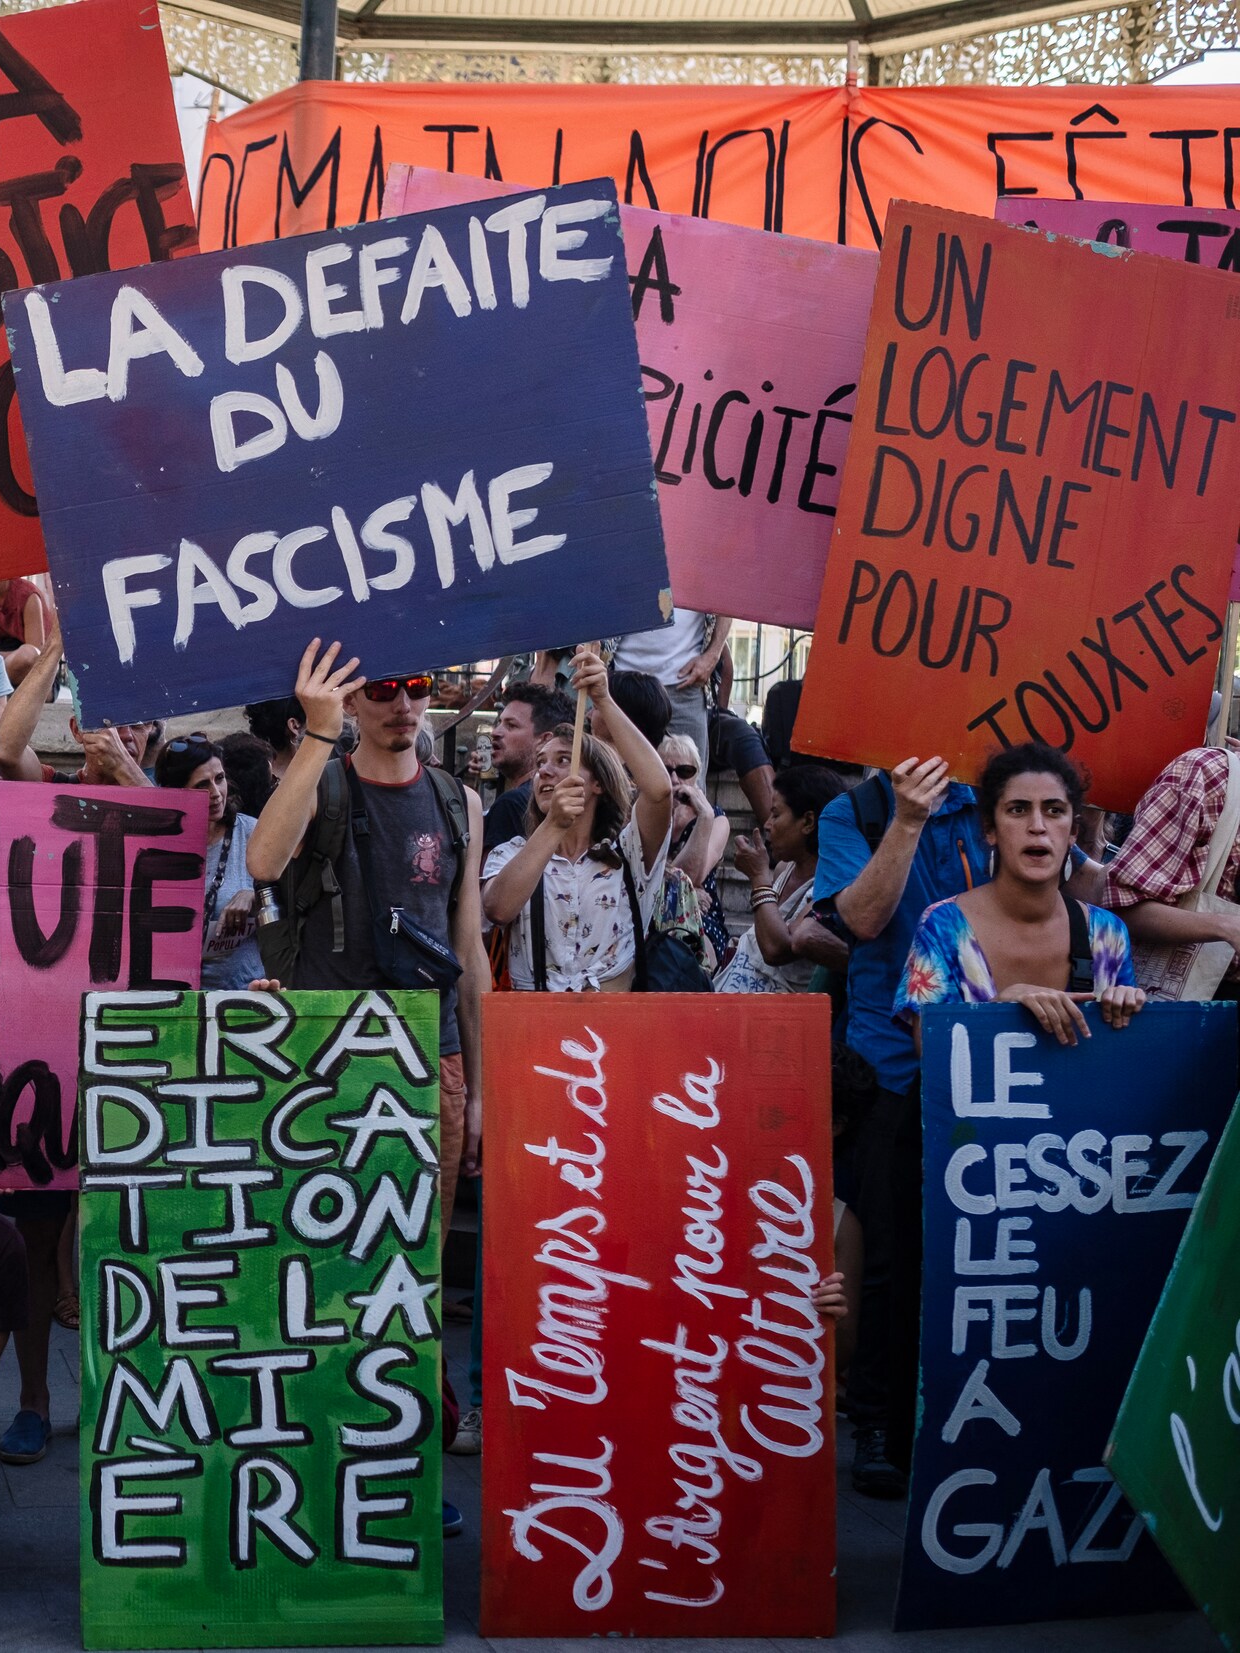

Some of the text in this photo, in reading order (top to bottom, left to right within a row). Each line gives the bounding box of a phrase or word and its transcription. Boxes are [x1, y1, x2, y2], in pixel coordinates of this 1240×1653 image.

[24, 194, 615, 407] LA DEFAITE
[893, 224, 993, 341] UN
[210, 350, 344, 472] DU
[873, 341, 1237, 496] LOGEMENT
[861, 445, 1092, 570] DIGNE
[102, 462, 567, 664] FASCISME
[838, 559, 1012, 677] POUR
[81, 990, 438, 1086] ERA
[533, 1025, 607, 1127] de
[950, 1022, 1053, 1118] LE
[81, 1077, 440, 1173] DICA
[650, 1056, 726, 1130] la
[81, 1166, 437, 1262] TION
[523, 1132, 607, 1198] et
[944, 1129, 1208, 1215] CESSEZ
[670, 1144, 749, 1310] pour
[954, 1217, 1040, 1275] LE
[101, 1253, 441, 1352] DE LA
[505, 1206, 653, 1410] Temps
[952, 1285, 1092, 1361] FEU
[93, 1341, 434, 1454] MIS
[941, 1359, 1021, 1443] A
[90, 1435, 424, 1570] ÈRE
[921, 1466, 1152, 1575] GAZ
